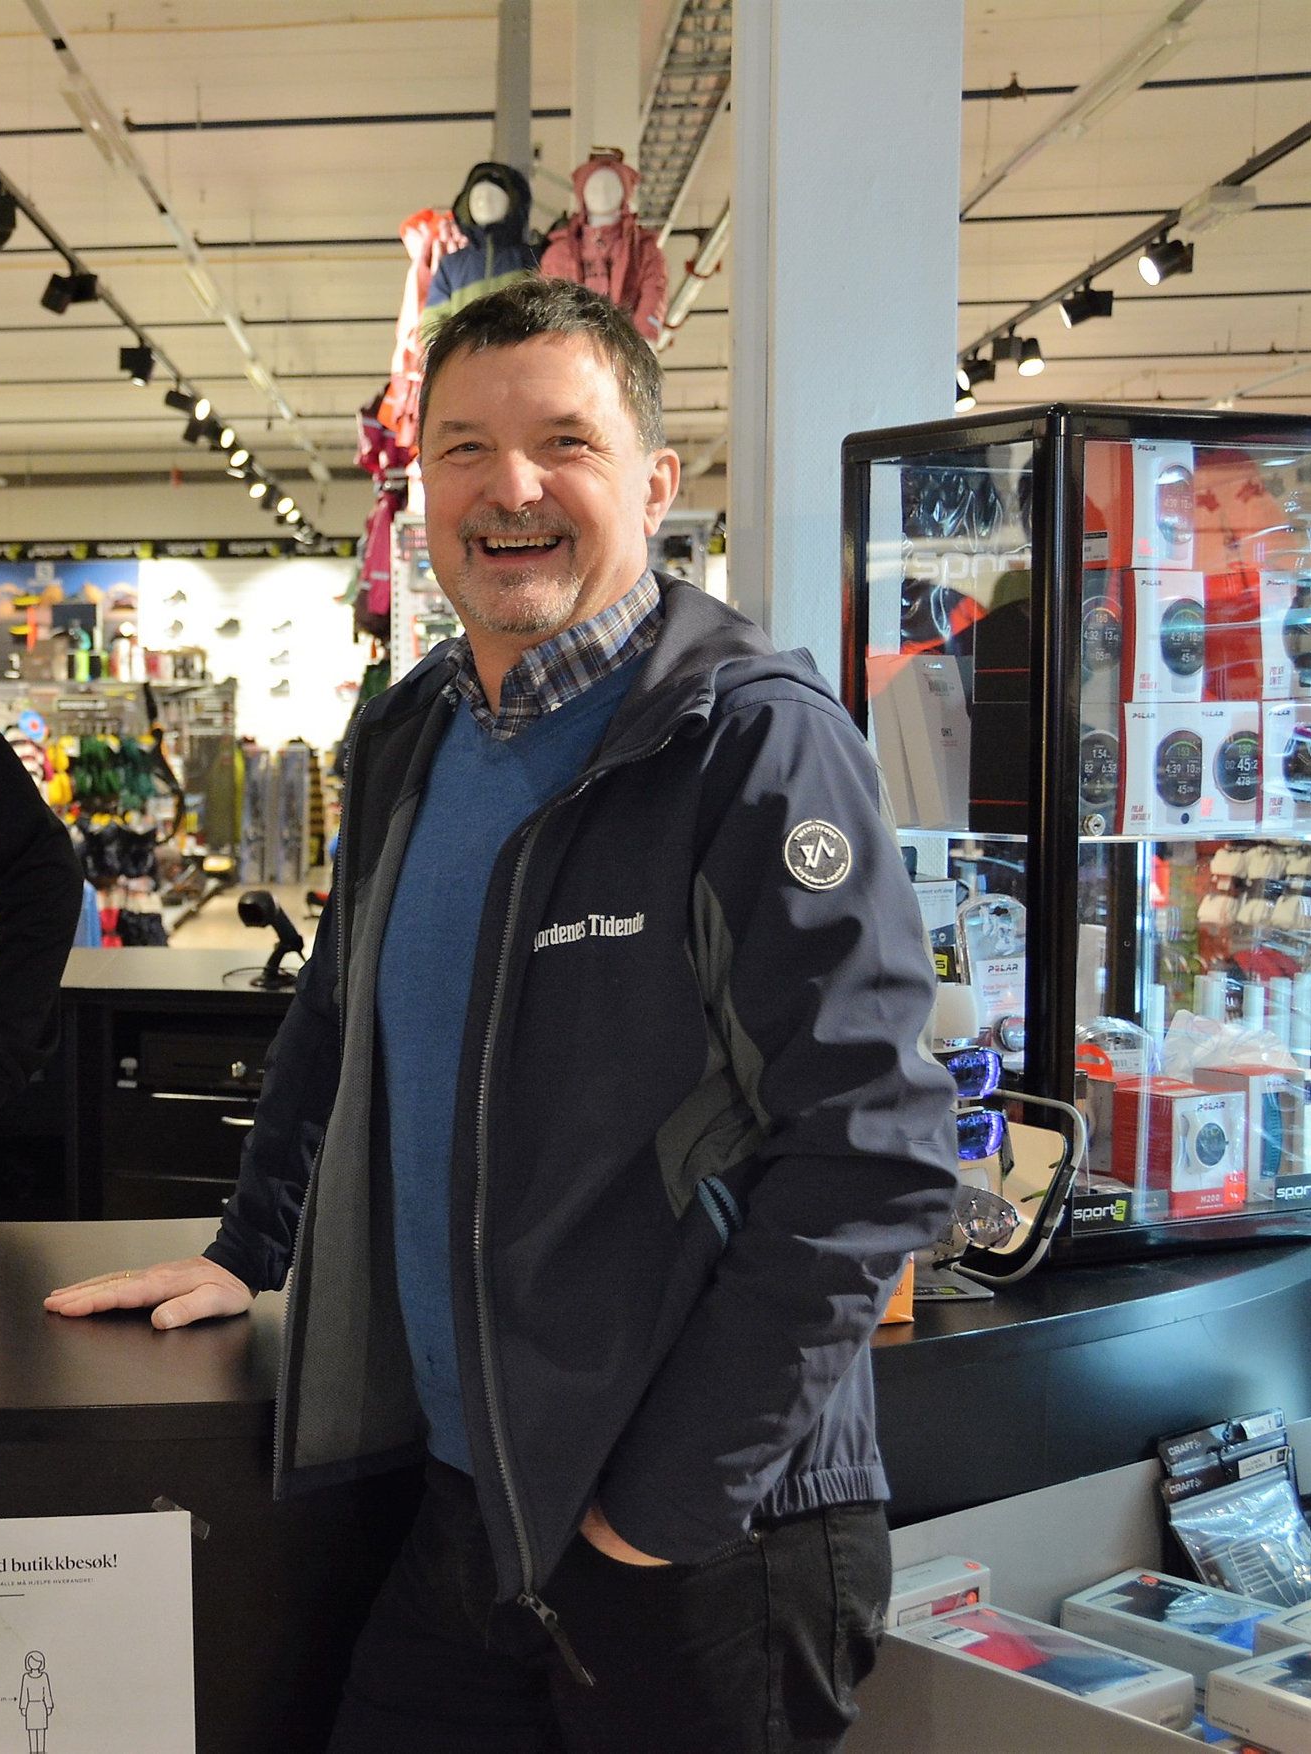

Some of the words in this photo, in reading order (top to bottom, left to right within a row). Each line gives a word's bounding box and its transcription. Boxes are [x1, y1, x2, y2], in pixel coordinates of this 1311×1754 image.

[533, 919, 586, 952] jordenes
[588, 911, 645, 937] Tidende
[988, 963, 1019, 973] POLAR
[1197, 1101, 1226, 1112] POLAR
[1200, 1194, 1221, 1203] M200
[1073, 1200, 1127, 1221] sports
[1168, 1440, 1194, 1456] CRAFT
[1169, 1479, 1195, 1495] CRAFT
[11, 1554, 117, 1572] butikkbesøk!
